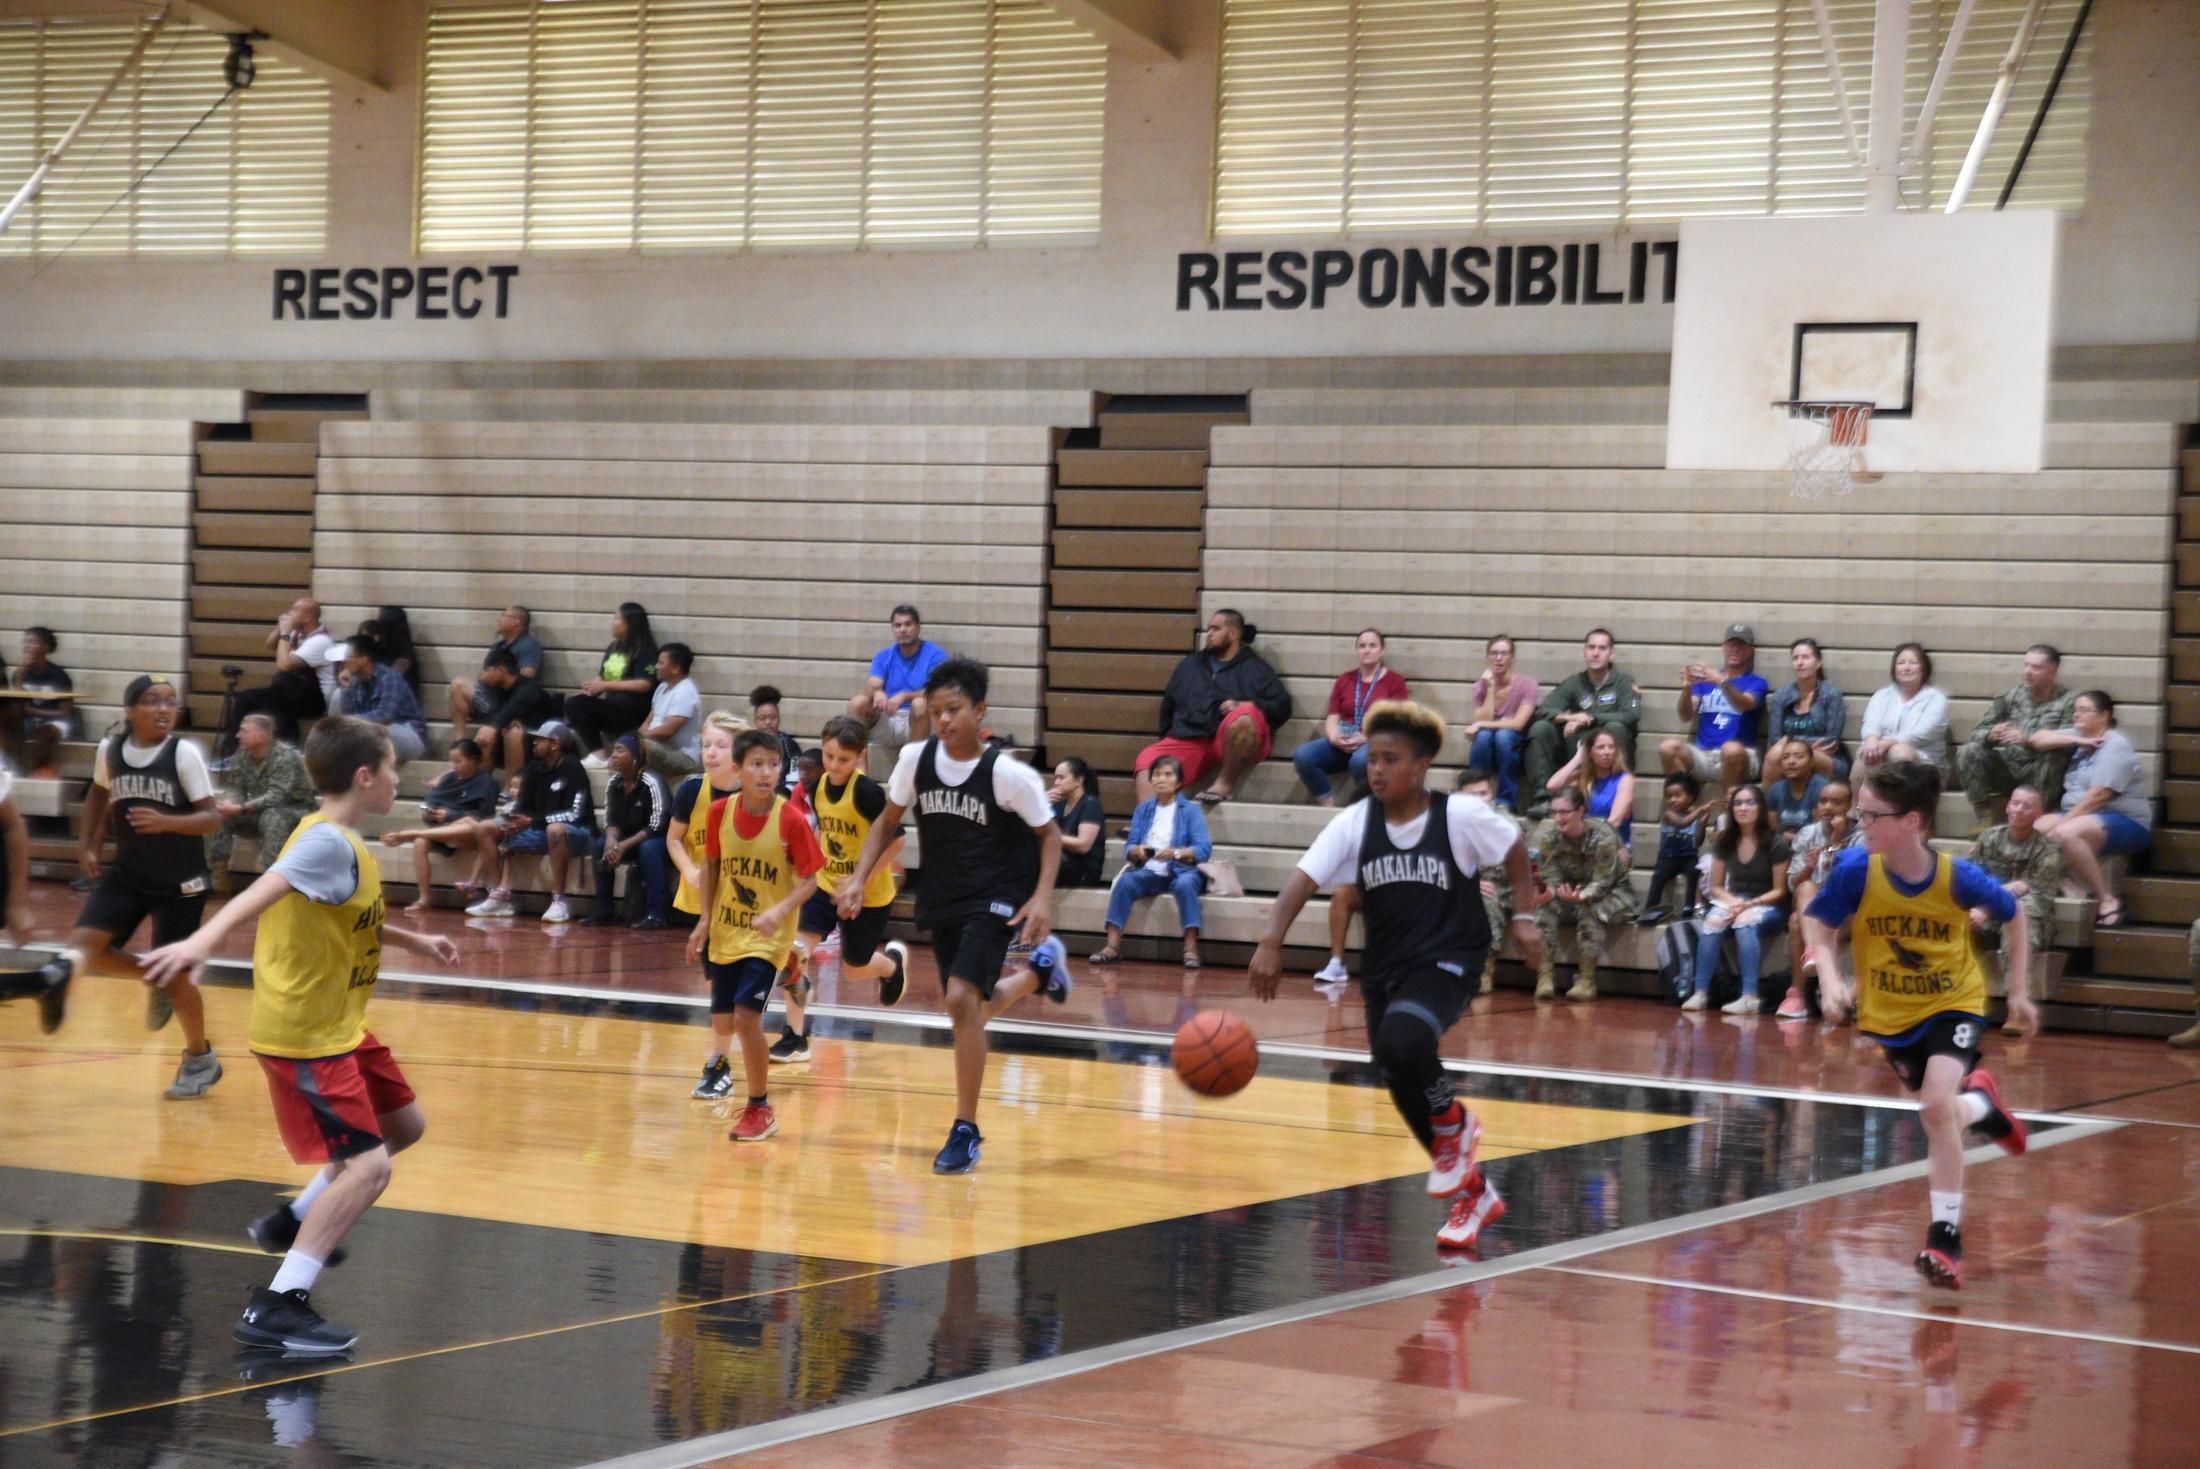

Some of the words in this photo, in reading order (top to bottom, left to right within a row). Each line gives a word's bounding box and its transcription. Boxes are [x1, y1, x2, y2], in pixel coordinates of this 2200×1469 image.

[273, 265, 519, 321] RESPECT
[1176, 241, 1678, 310] RESPONSIBILIT
[919, 788, 988, 826] MAKALAPA
[1362, 854, 1448, 891] MAKALAPA
[1866, 915, 1950, 942] HICKAM
[1870, 968, 1953, 995] FALCONS
[1953, 1023, 1971, 1049] 8
